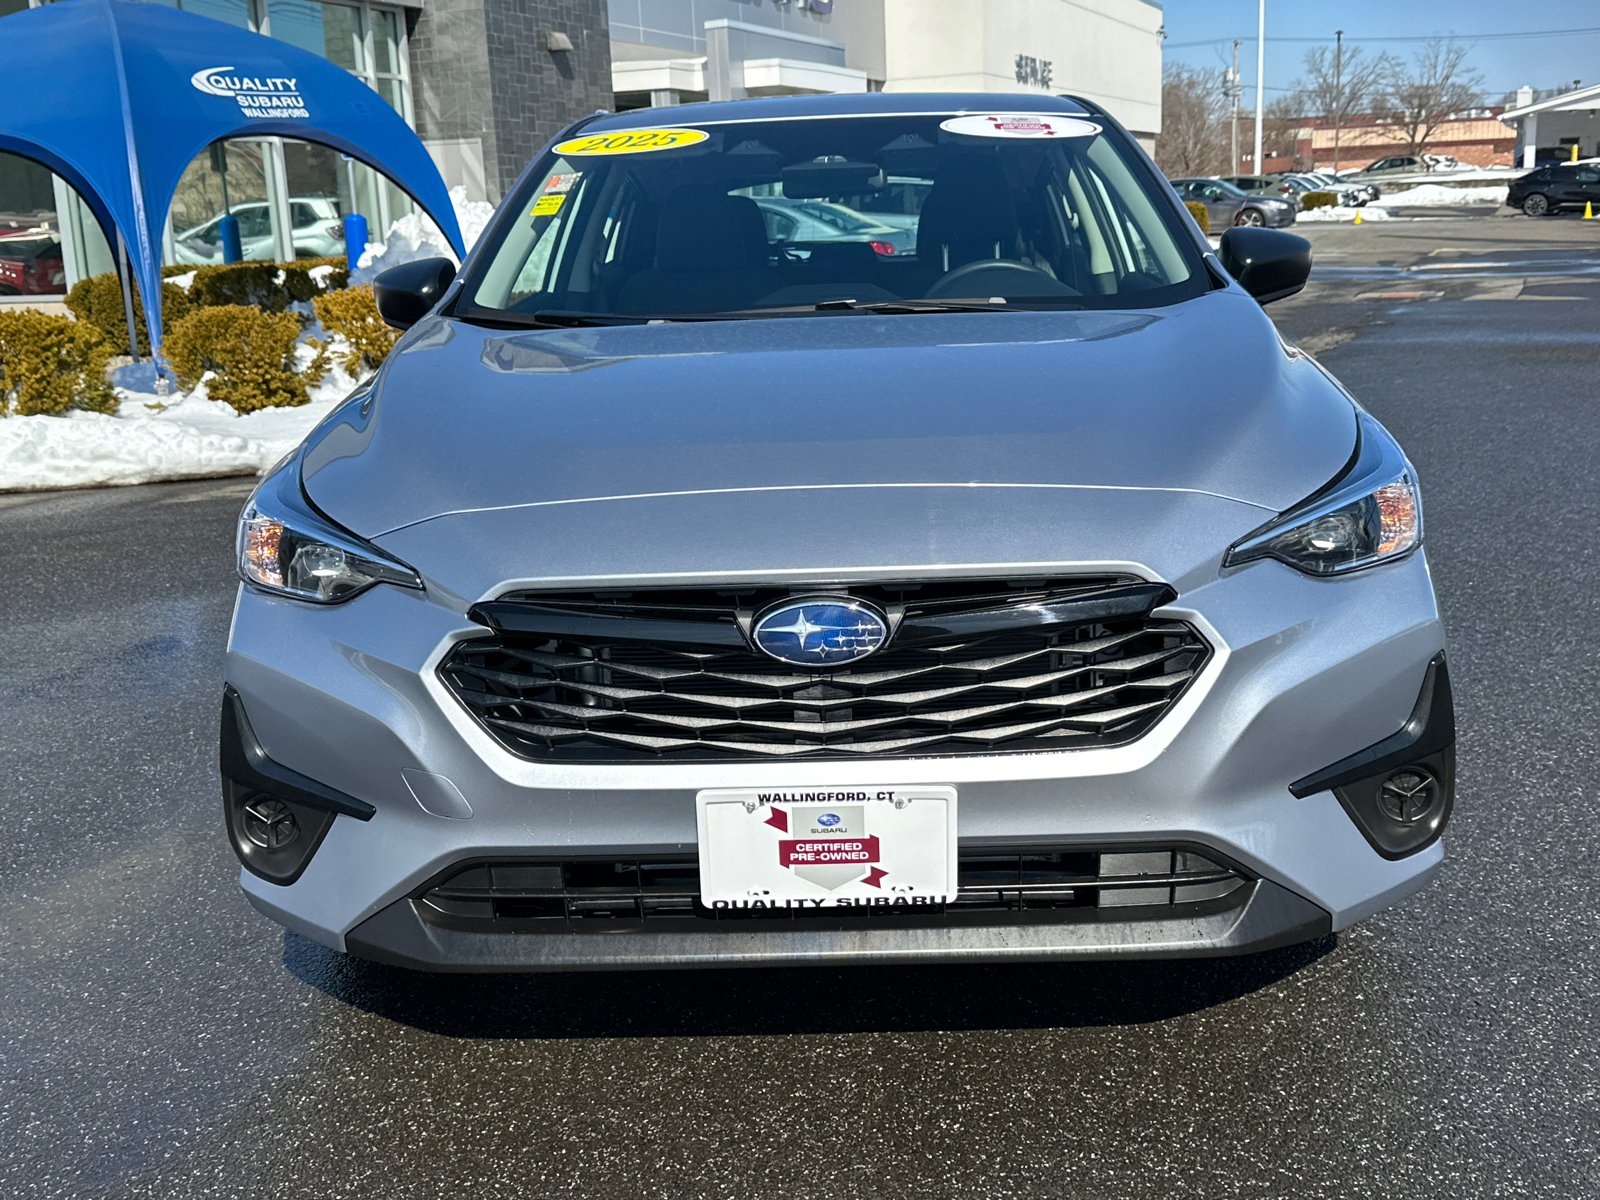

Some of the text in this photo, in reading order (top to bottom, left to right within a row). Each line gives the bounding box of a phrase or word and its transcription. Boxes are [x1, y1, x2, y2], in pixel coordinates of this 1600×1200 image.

[209, 76, 297, 90] QUALITY
[236, 95, 304, 107] SUBARU
[241, 107, 309, 118] WALLINGFORD
[577, 132, 685, 151] 2025
[757, 791, 895, 803] WALLINGFORD, CT
[795, 842, 863, 852] CERTIFIED
[789, 851, 869, 861] PRE-OWNED
[712, 895, 948, 910] QUALITY SUBARU
